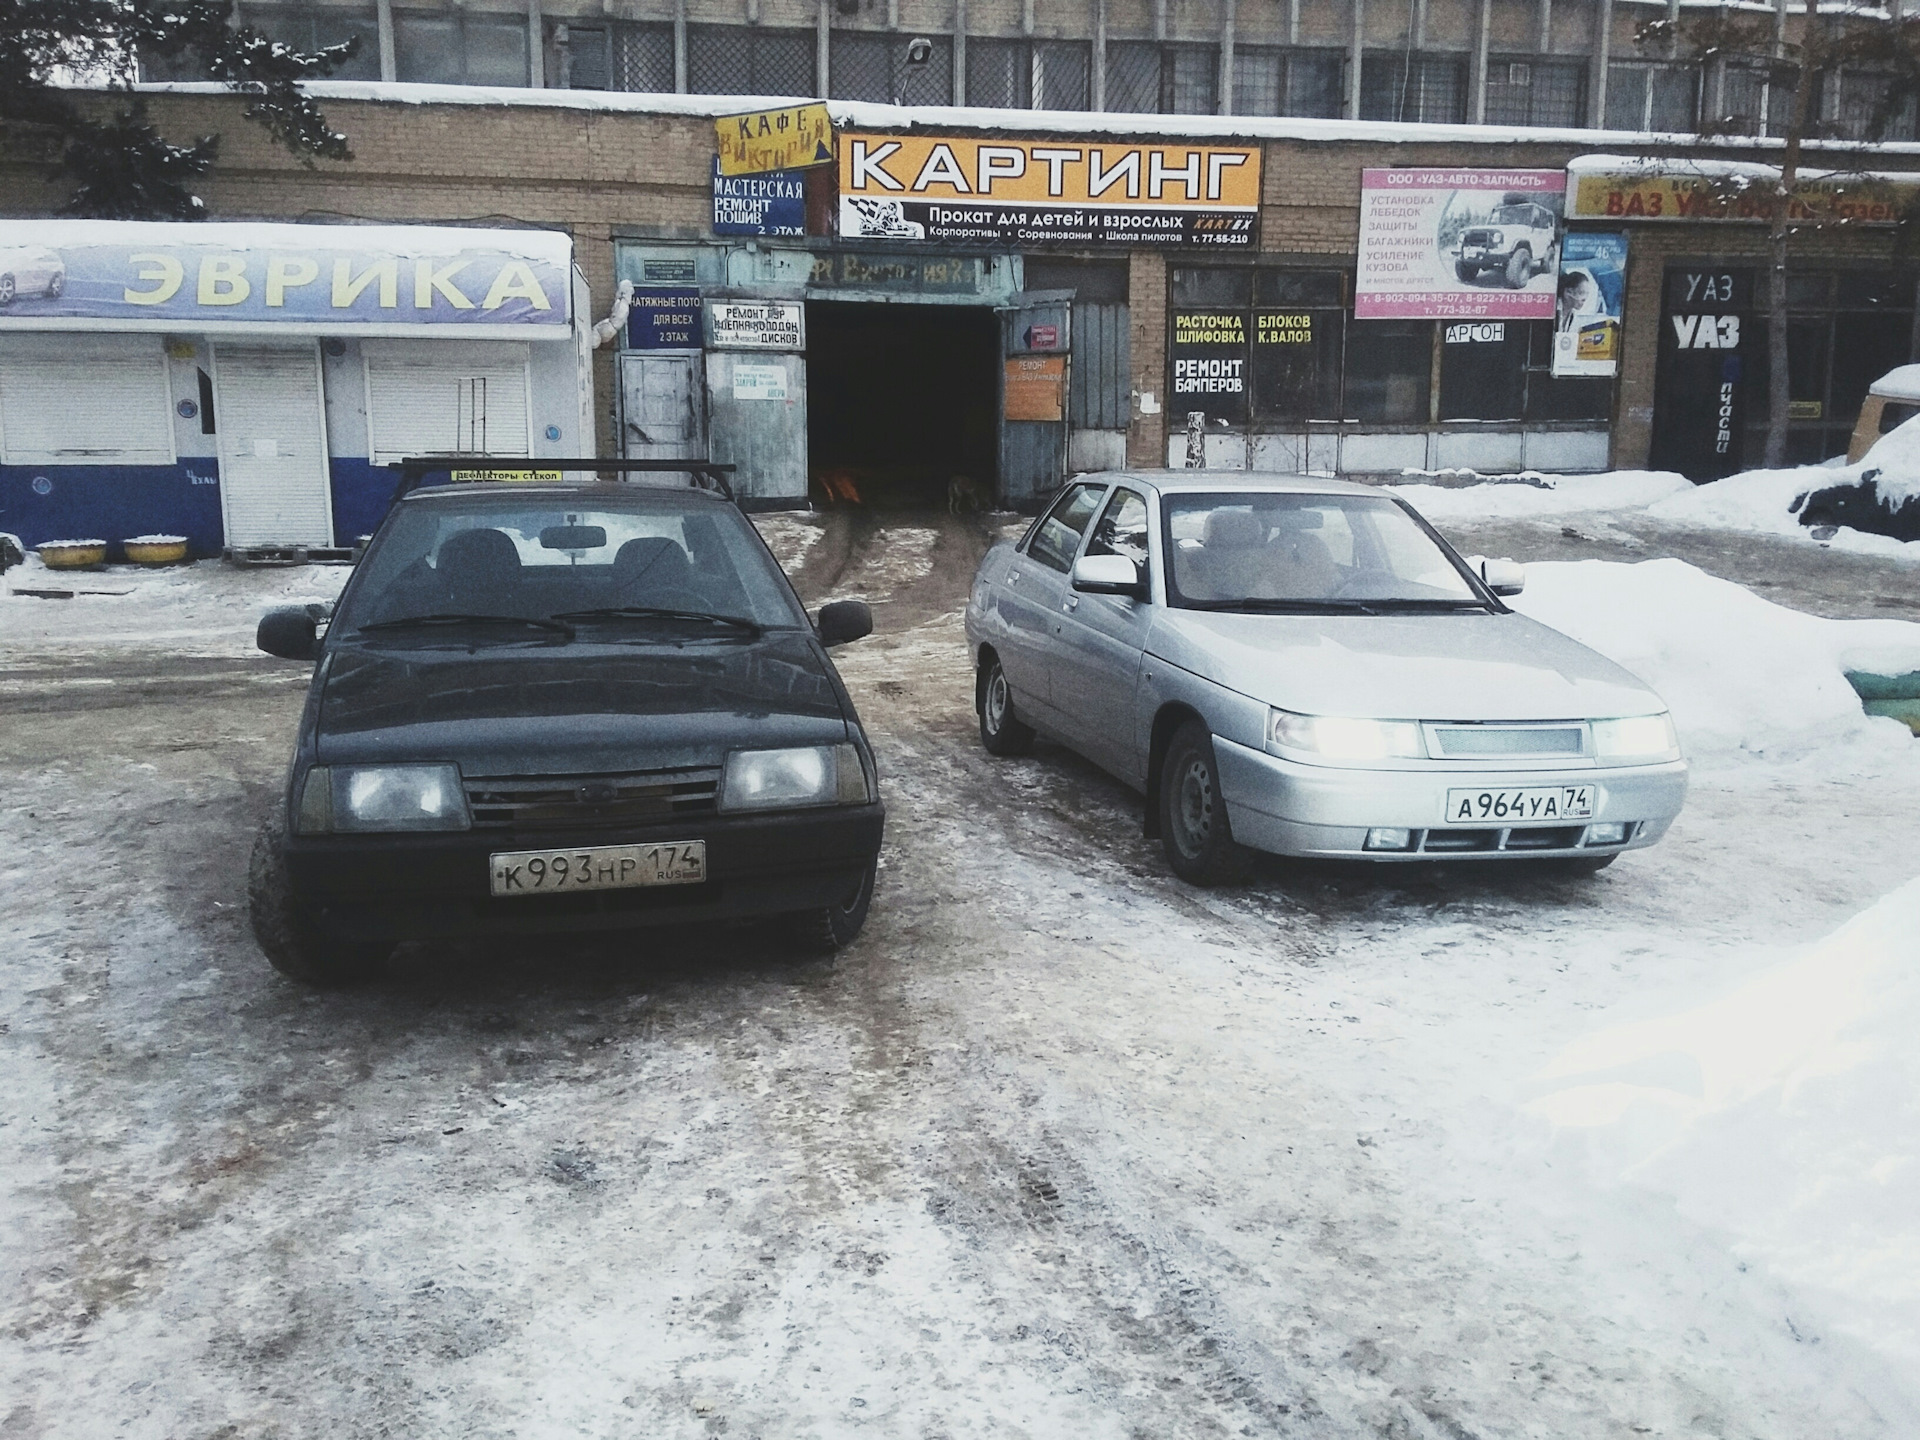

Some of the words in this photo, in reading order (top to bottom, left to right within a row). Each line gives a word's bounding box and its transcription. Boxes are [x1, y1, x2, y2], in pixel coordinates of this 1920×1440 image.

[739, 109, 807, 140] КАФЕ
[851, 139, 1251, 201] КАРТИНГ
[1387, 174, 1413, 184] ООО
[714, 177, 803, 199] МАСТЕРСКАЯ
[714, 197, 772, 212] РЕМОНТ
[1370, 196, 1435, 206] УСТАНОВКА
[1606, 191, 1663, 218] ВАЗ
[714, 210, 762, 225] ПОШИВ
[929, 206, 994, 225] Прокат
[997, 212, 1027, 226] для
[1031, 210, 1084, 227] детей
[1088, 215, 1098, 227] и
[1103, 214, 1184, 230] взрослых
[1369, 208, 1421, 218] ЛЕБЕДОК
[758, 226, 766, 235] 2
[772, 226, 804, 236] ЭТАЖ
[1193, 218, 1253, 231] KARTEX
[1368, 222, 1418, 232] ЗАЩИТЫ
[929, 225, 1000, 240] Корпоративы
[1017, 228, 1093, 242] Соревнования
[1105, 230, 1139, 242] Школа
[1141, 232, 1183, 243] пилотов
[1191, 235, 1199, 243] т.
[1202, 233, 1249, 244] 77-55-210
[1367, 236, 1434, 247] БАГАЖНИКИ
[1366, 251, 1425, 261] УСИЛЕНИЕ
[1365, 262, 1409, 272] КУЗОВА
[123, 253, 552, 310] ЭВРИКА
[1686, 274, 1733, 301] УАЗ
[631, 297, 676, 307] НАТЯЖНЫЕ
[653, 314, 670, 326] ДЛЯ
[672, 314, 694, 325] ВСЕХ
[726, 308, 764, 319] РЕМОНТ
[1176, 315, 1242, 328] РАСТОЧКА
[1258, 315, 1311, 329] БЛОКОВ
[659, 331, 665, 341] 2
[666, 331, 689, 342] ЭТАЖ
[761, 333, 798, 344] ДИСКОВ
[1176, 330, 1245, 343] ШЛИФОВКА
[1258, 330, 1312, 343] К.ВАЛОВ
[1447, 324, 1503, 342] АРГОН
[1672, 315, 1741, 349] УАЗ
[1175, 359, 1243, 378] РЕМОНТ
[1175, 378, 1243, 393] БАМПЕРОВ
[458, 471, 518, 480] ДЕФЛЕКТОРЫ
[523, 472, 557, 481] СТЕКОЛ
[1458, 792, 1557, 818] А964УА
[1566, 789, 1586, 808] 74
[1563, 808, 1579, 816] RUS
[504, 855, 636, 890] К993НР
[647, 846, 699, 869] 174
[657, 871, 682, 880] RUS
